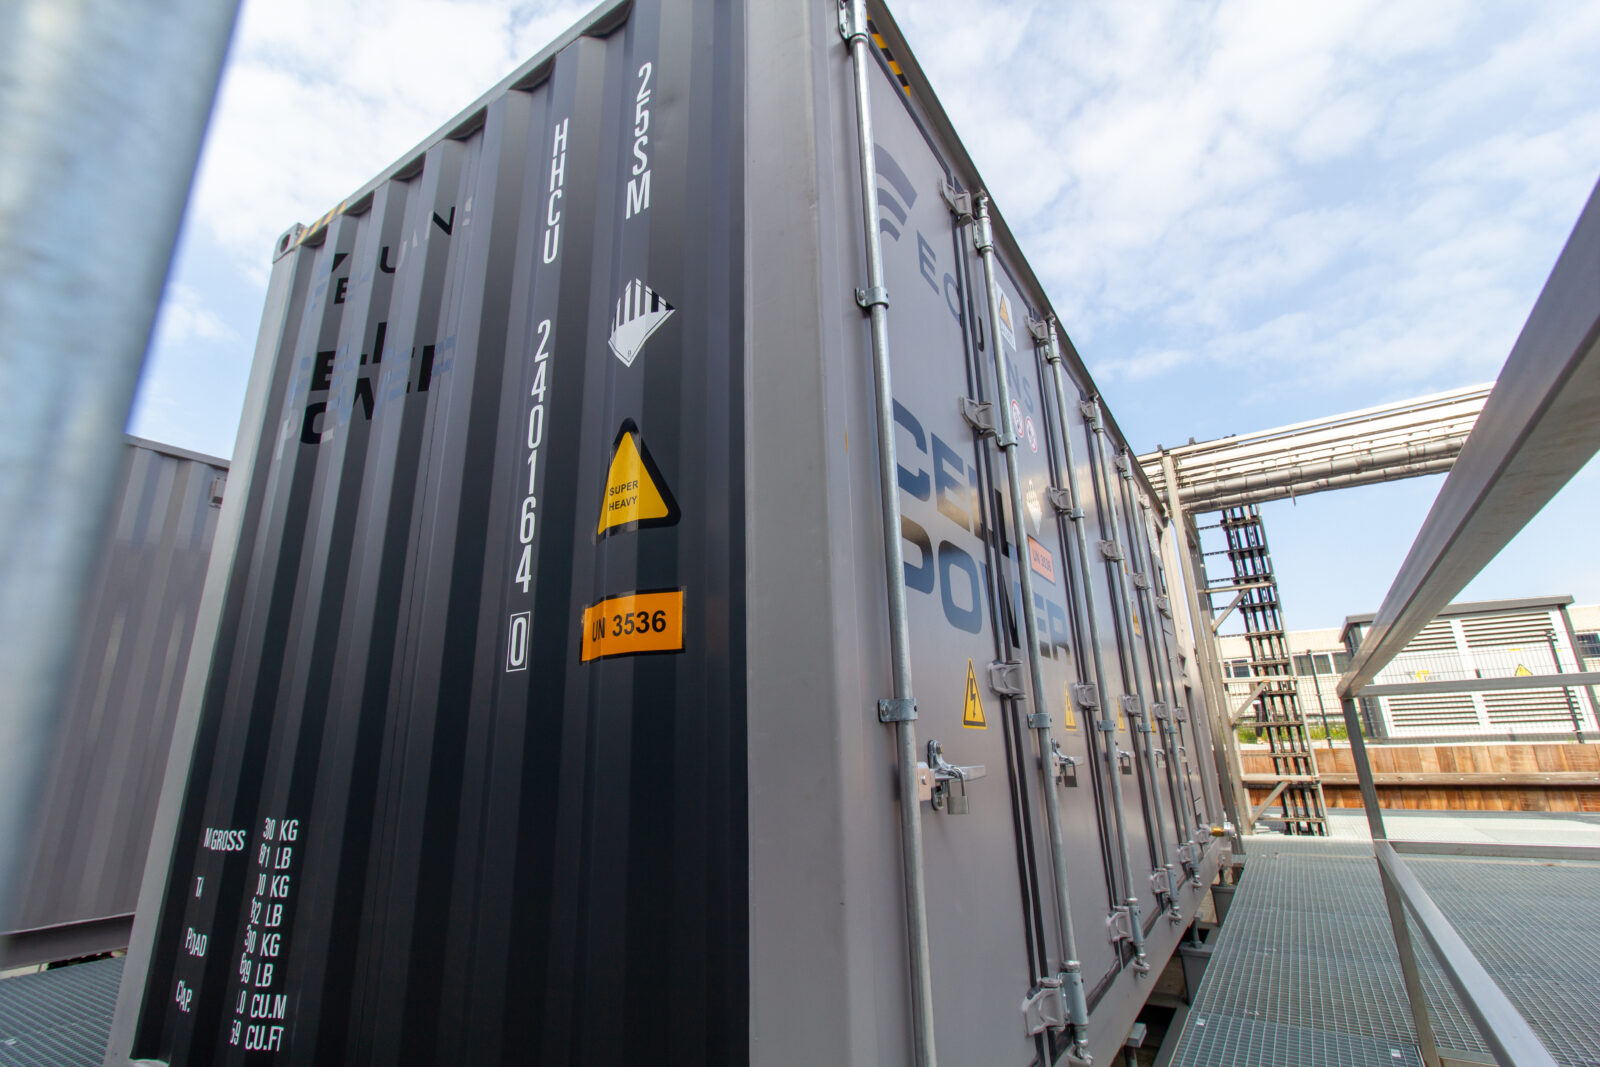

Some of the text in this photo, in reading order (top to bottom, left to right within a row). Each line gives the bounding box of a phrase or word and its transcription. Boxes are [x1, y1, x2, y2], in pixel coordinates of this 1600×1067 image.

[609, 480, 639, 496] SUPER
[608, 495, 638, 512] HEAVY
[592, 610, 667, 643] UN 3536
[279, 819, 299, 842] KG
[274, 847, 292, 869] LB
[269, 875, 290, 898] KG
[264, 903, 283, 927] LB
[260, 933, 281, 957] KG
[254, 963, 273, 988] LB
[250, 993, 287, 1020] CU.M
[245, 1025, 285, 1052] CU.FT
